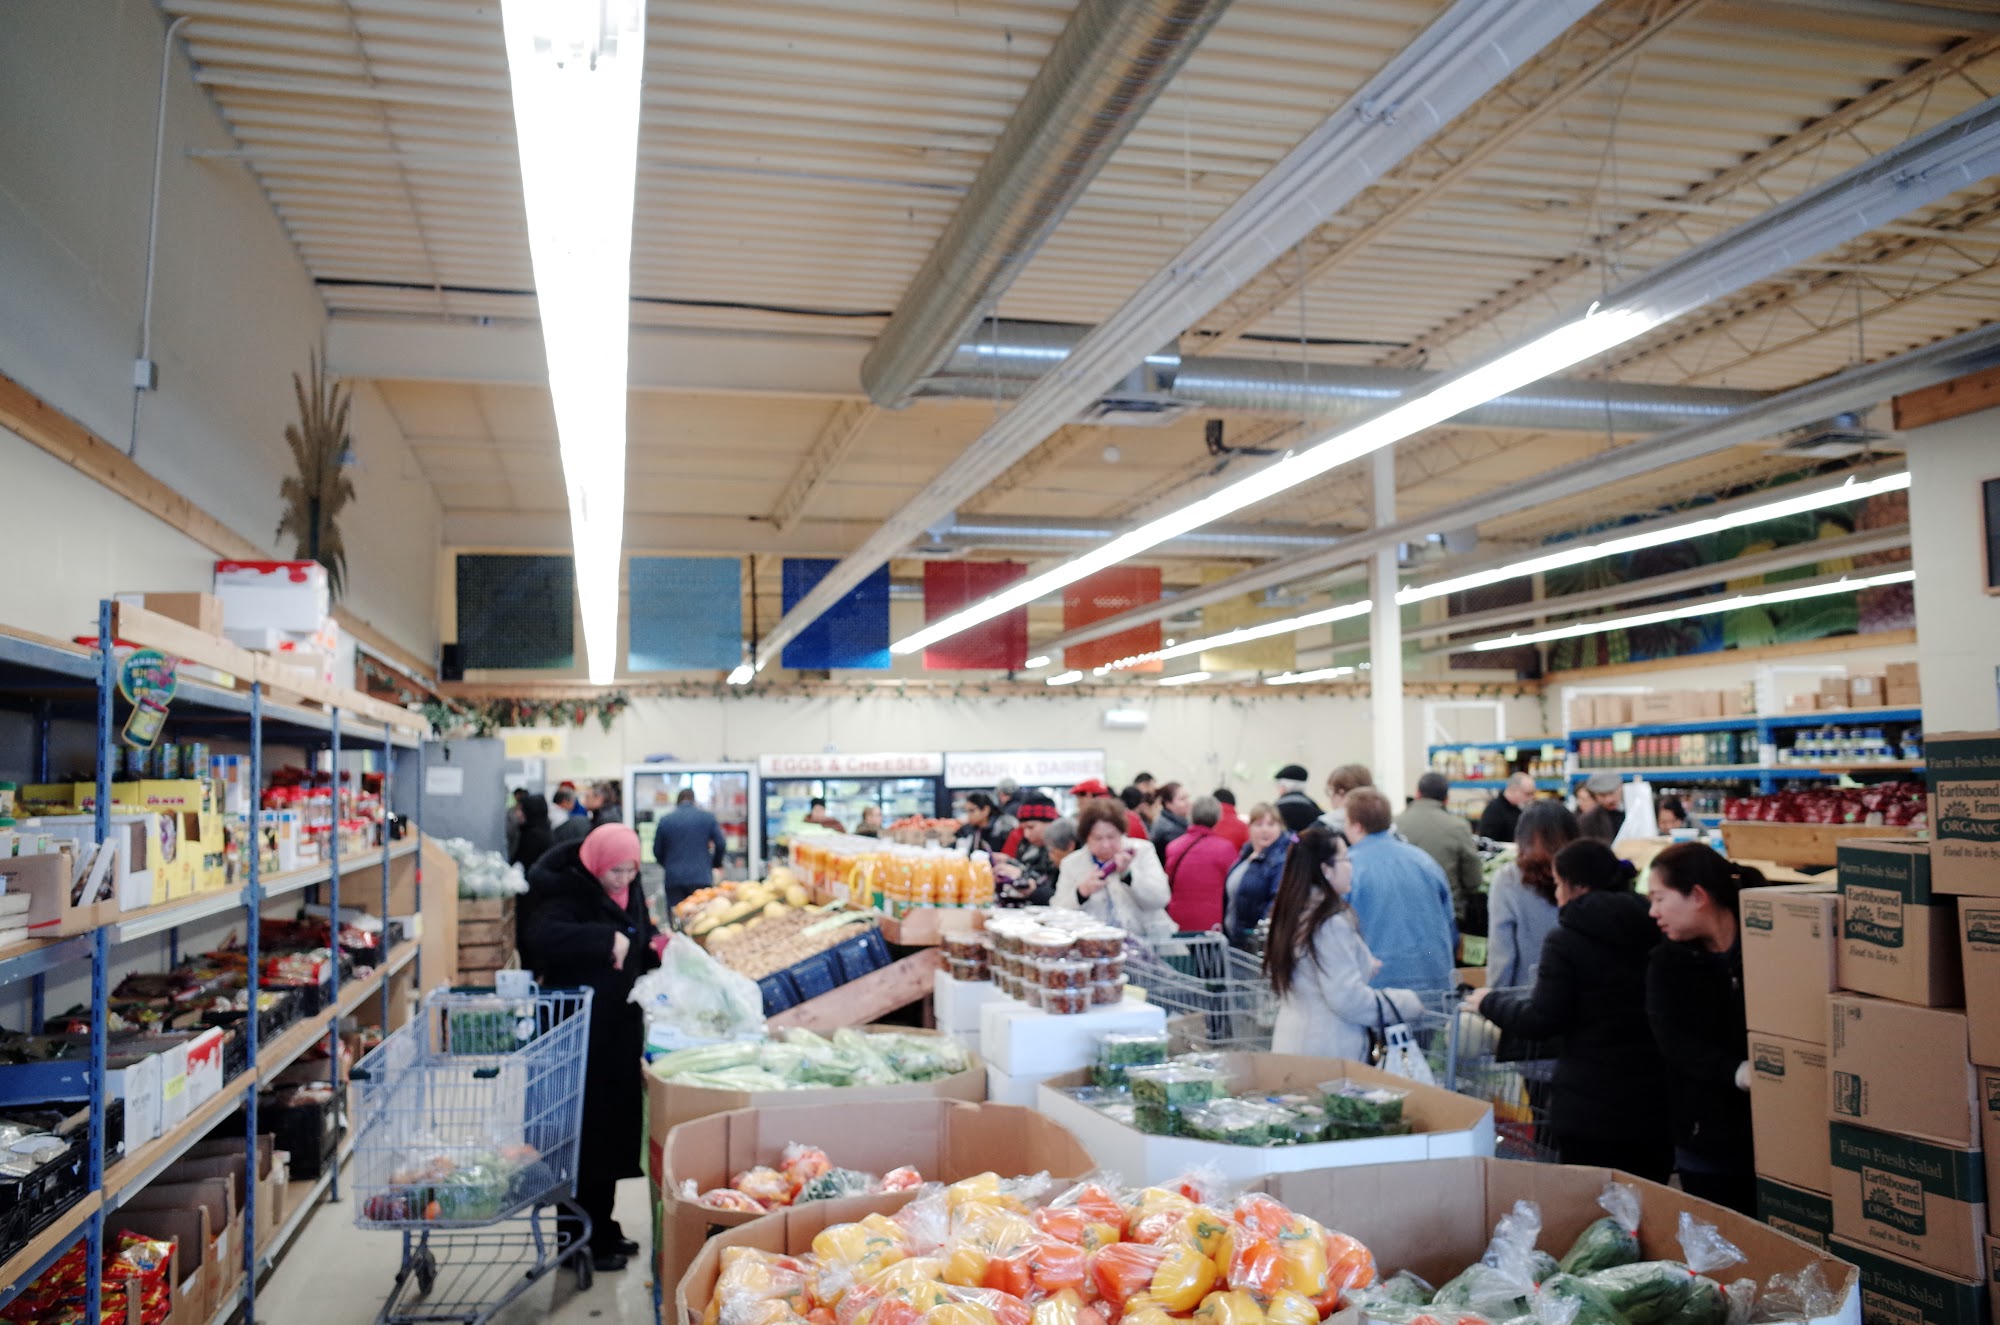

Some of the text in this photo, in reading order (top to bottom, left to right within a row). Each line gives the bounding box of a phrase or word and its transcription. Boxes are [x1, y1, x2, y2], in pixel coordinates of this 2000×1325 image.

[771, 757, 824, 773] EGGS
[829, 757, 841, 772] &
[1930, 757, 1953, 769] Farm
[1954, 756, 1980, 768] Fresh
[1940, 783, 1999, 798] Earthbound
[1974, 799, 2000, 814] Farm
[1942, 820, 2000, 835] ORGANIC
[1848, 888, 1900, 907] Earthbound
[1877, 906, 1900, 921] Farm
[1848, 921, 1898, 942] ORGANIC
[1840, 1139, 1943, 1180] Farm Fresh Salad
[1864, 1169, 1920, 1196] Earthbound
[1896, 1192, 1921, 1210] Farm
[1867, 1203, 1921, 1230] ORGANIC
[1873, 1271, 1907, 1297] Fresh
[1909, 1283, 1944, 1310] Salad
[1865, 1292, 1920, 1323] Earthbound
